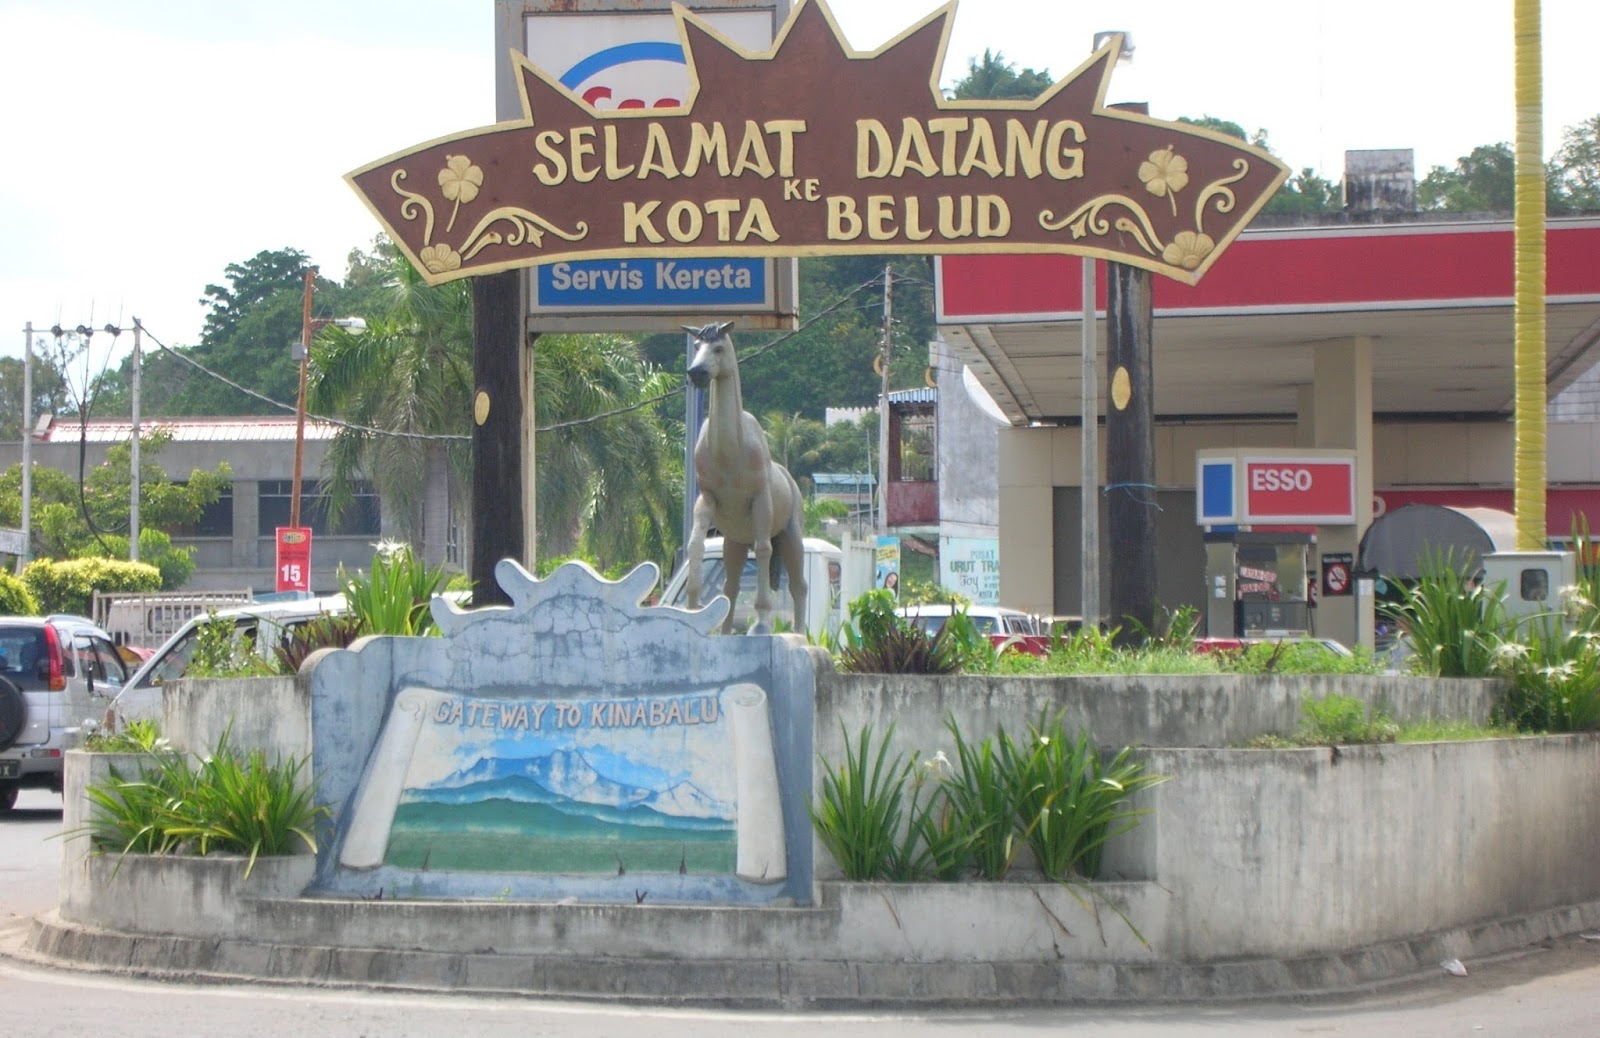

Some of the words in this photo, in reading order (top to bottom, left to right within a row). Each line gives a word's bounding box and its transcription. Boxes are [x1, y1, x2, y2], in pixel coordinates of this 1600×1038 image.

[532, 120, 807, 186] SELAMAT
[855, 116, 1087, 180] DATANG
[784, 179, 821, 201] KE
[623, 198, 780, 243] KOTA
[827, 194, 1011, 241] BELUD
[552, 262, 643, 291] Servis
[656, 262, 751, 290] Kereta
[1252, 469, 1313, 491] ESSO
[281, 564, 301, 582] 15
[950, 560, 976, 573] URUT
[433, 701, 548, 731] GATEWAY
[555, 703, 582, 728] TO
[591, 696, 719, 729] KINABALU
